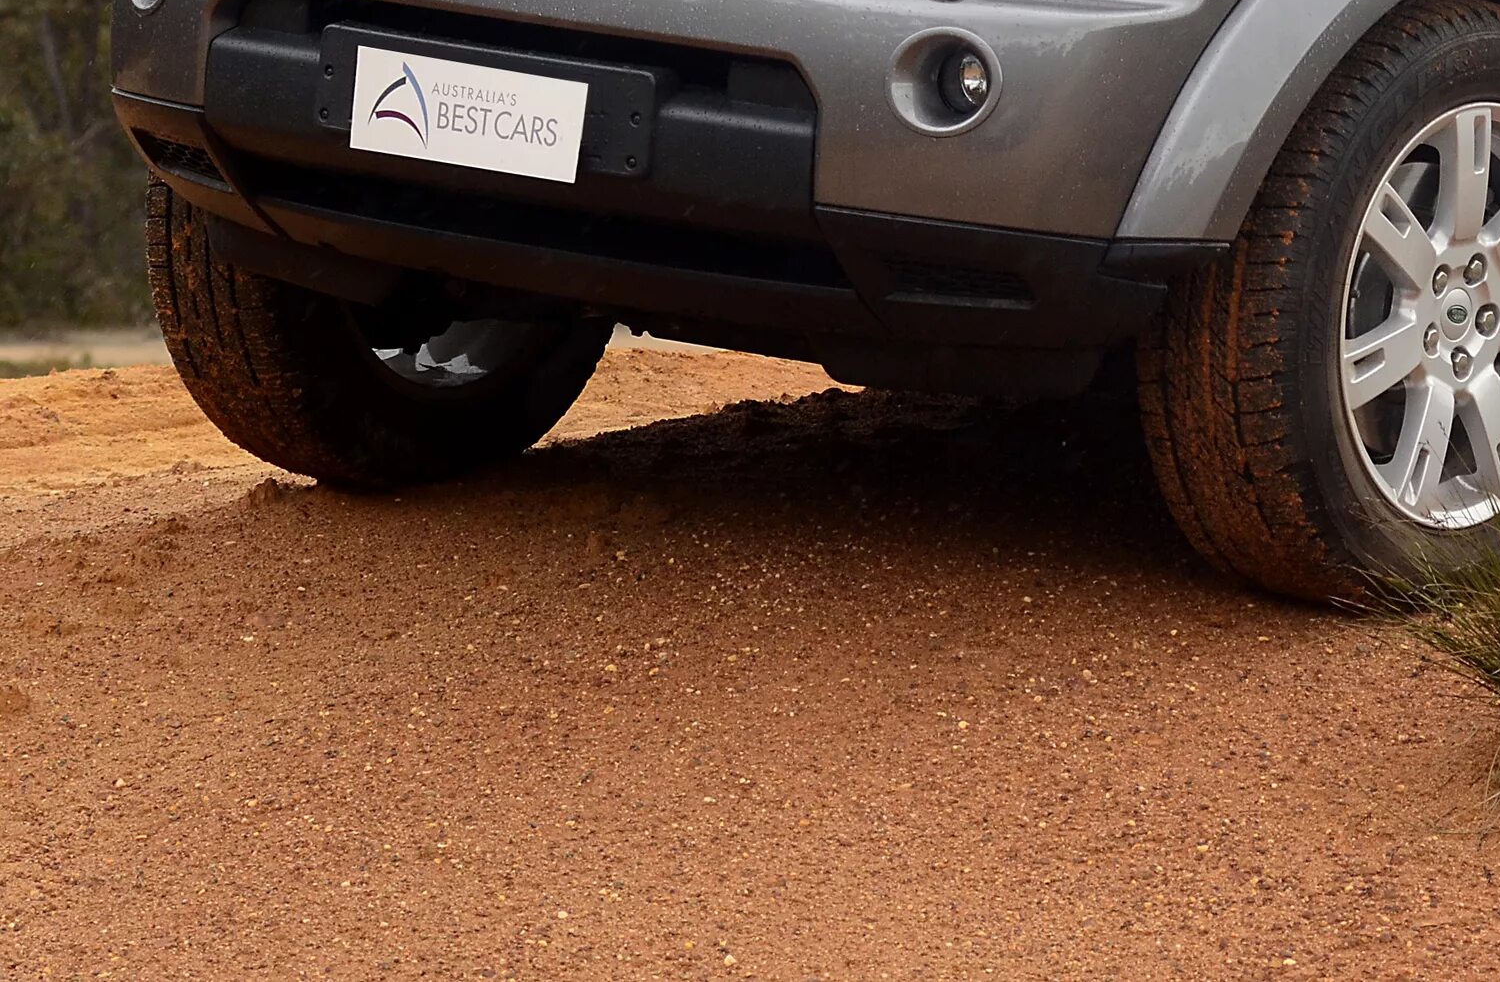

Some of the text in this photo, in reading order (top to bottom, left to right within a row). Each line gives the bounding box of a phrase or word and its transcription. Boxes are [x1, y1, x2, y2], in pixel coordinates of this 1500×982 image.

[432, 82, 518, 107] AUSTRALIA'S
[436, 101, 559, 147] BEST CARS
